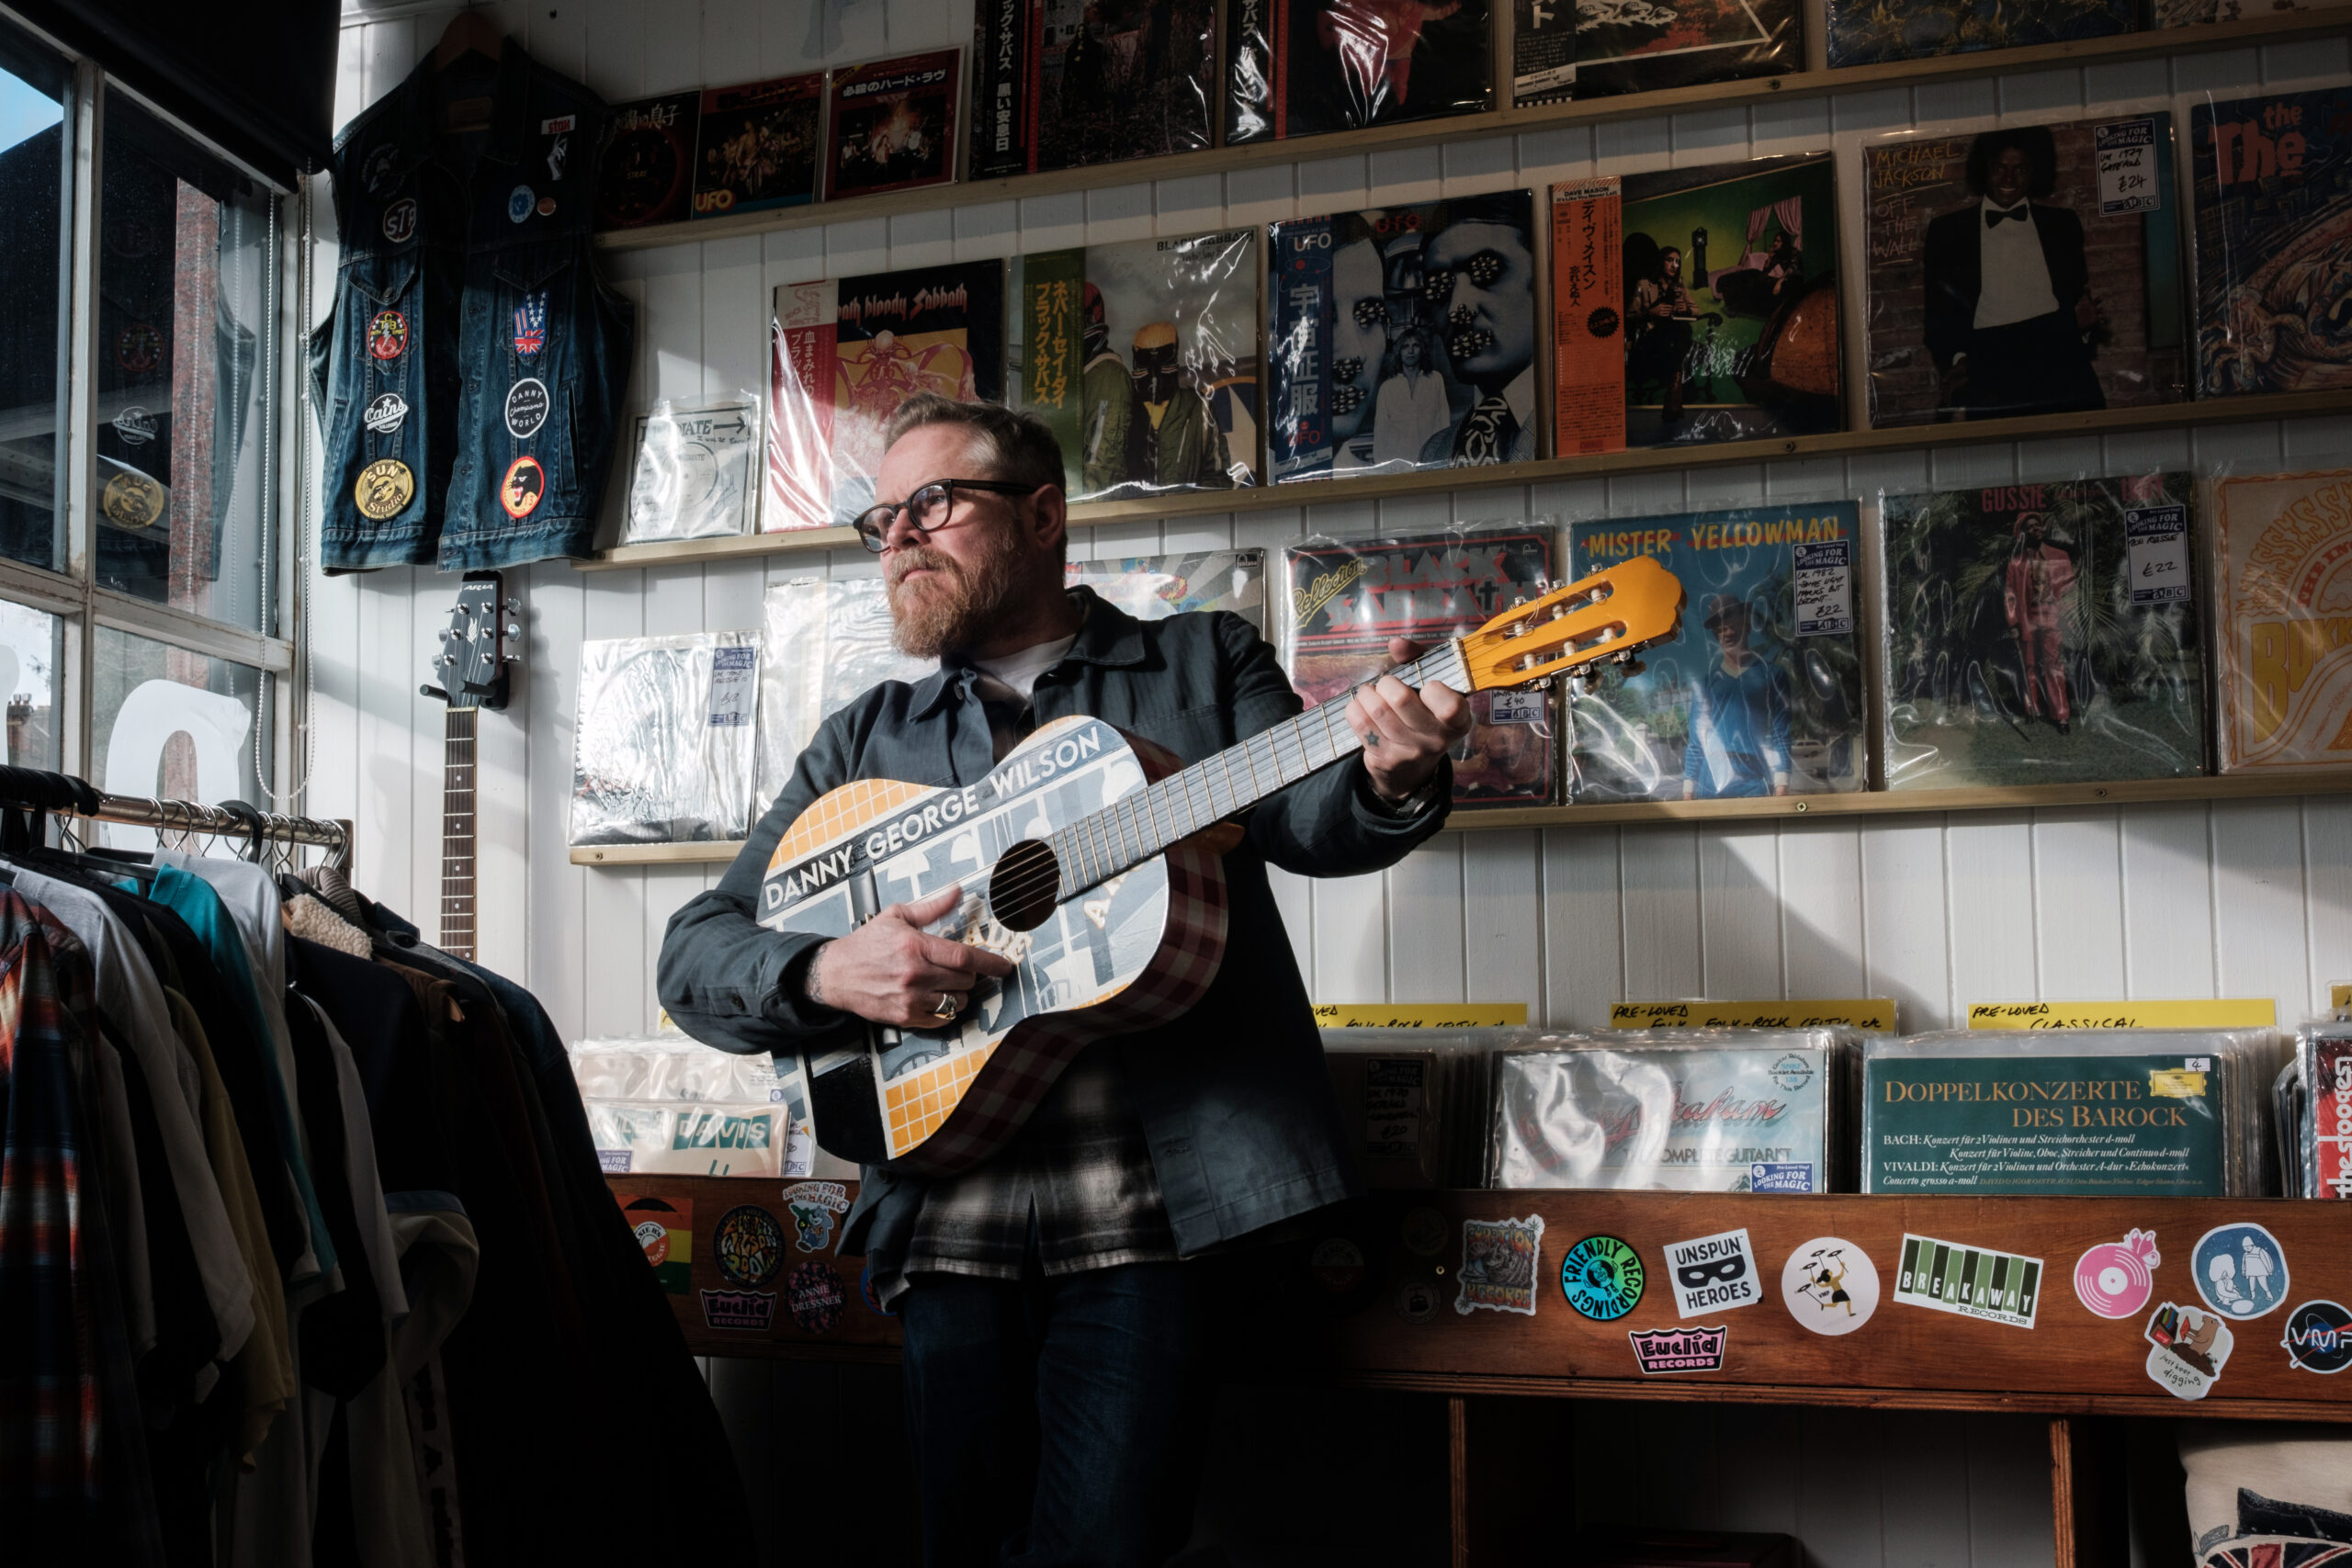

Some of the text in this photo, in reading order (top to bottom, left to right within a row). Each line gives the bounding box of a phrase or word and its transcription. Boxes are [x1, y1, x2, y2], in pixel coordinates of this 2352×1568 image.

[2263, 102, 2304, 130] the
[2118, 135, 2153, 145] MAGIC
[1875, 142, 1960, 169] MICHAEL
[2207, 119, 2307, 187] The
[1874, 161, 1946, 188] JACKSON
[2119, 174, 2147, 193] £24
[695, 188, 733, 212] UFO
[1565, 186, 1610, 197] DAVE MASON
[1875, 196, 1916, 219] OFF
[1374, 213, 1421, 234] UFO
[1882, 215, 1917, 236] THE
[1294, 231, 1332, 253] UFO
[1582, 198, 1597, 290] デイヴ・メイスン
[1872, 236, 1917, 258] WALL
[865, 282, 968, 321] bloody Sabbath
[1035, 282, 1052, 406] ブラック・サバス
[1051, 279, 1069, 410] ネバー・セイ・ダイ
[512, 389, 543, 403] DANNY
[511, 413, 541, 428] WORLD
[367, 464, 399, 482] SUN
[368, 493, 403, 513] Studio
[1981, 484, 2047, 513] GUSSIE
[2129, 513, 2178, 533] LOOKING FOR
[2148, 523, 2183, 531] MAGIC
[1588, 516, 1839, 558] MISTER YELLOWMAN
[1796, 547, 1843, 567] LOOKING FOR
[1815, 557, 1847, 565] MAGIC
[1360, 546, 1510, 589] BLACK
[1812, 568, 1835, 577] 1982
[2143, 561, 2178, 577] £22
[1292, 557, 1367, 615] Reflection
[1323, 580, 1539, 627] SABBATH
[1815, 604, 1843, 618] £22
[728, 660, 752, 669] MAGIC
[736, 652, 751, 660] FOR
[1503, 696, 1525, 708] £40
[764, 726, 1102, 910] DANNY GEORGE WILSON
[1612, 1004, 1689, 1019] PRE-LOVED
[1973, 1002, 2050, 1018] PRE-LOVED
[2191, 1058, 2202, 1072] 4
[1885, 1080, 2142, 1103] DOPPELKONZERTE
[2012, 1105, 2188, 1128] DES BAROCK
[678, 1121, 767, 1141] DAVIS
[1883, 1134, 1922, 1145] BACH:
[1923, 1134, 1959, 1148] Konzert
[1959, 1134, 1975, 1147] für
[2019, 1134, 2036, 1145] und
[2038, 1134, 2104, 1145] Streichorchester
[2105, 1134, 2136, 1145] d-moll
[611, 1156, 627, 1165] FOR
[1950, 1148, 1985, 1162] Konzert
[1985, 1148, 2002, 1161] für
[2062, 1148, 2100, 1158] Streicher
[2100, 1147, 2118, 1158] und
[2119, 1147, 2159, 1157] Continuo
[2159, 1147, 2190, 1157] d-moll
[602, 1164, 628, 1173] MAGIC
[1883, 1161, 1939, 1172] VIVALDI:
[1939, 1161, 1976, 1176] Konzert
[1977, 1161, 1993, 1174] für
[2036, 1161, 2053, 1172] und
[2054, 1161, 2095, 1172] Orchester
[2095, 1161, 2123, 1172] A-dur
[821, 1182, 845, 1196] FOR
[1754, 1170, 1806, 1189] LOOKING FOR
[1774, 1180, 1811, 1191] MAGIC
[1883, 1175, 1978, 1188] Concerto grosso a-moll
[808, 1194, 848, 1212] MAGIC
[720, 1230, 777, 1258] WILSON
[1565, 1237, 1623, 1283] FRIENDLY
[798, 1284, 831, 1299] ANNIE
[1464, 1285, 1532, 1306] RECORDS
[1572, 1258, 1642, 1318] RECORDINGS
[1685, 1280, 1752, 1310] HEROES
[1817, 1289, 1831, 1300] VMP
[1902, 1269, 2032, 1314] BREAKAWAY
[708, 1297, 770, 1316] Euclid
[791, 1294, 842, 1314] DRESSNER
[712, 1317, 766, 1326] RECORDS
[1957, 1304, 2029, 1326] RECORDS
[1640, 1334, 1719, 1359] Euclid
[1647, 1357, 1715, 1370] RECORDS
[2164, 1368, 2201, 1388] digging
